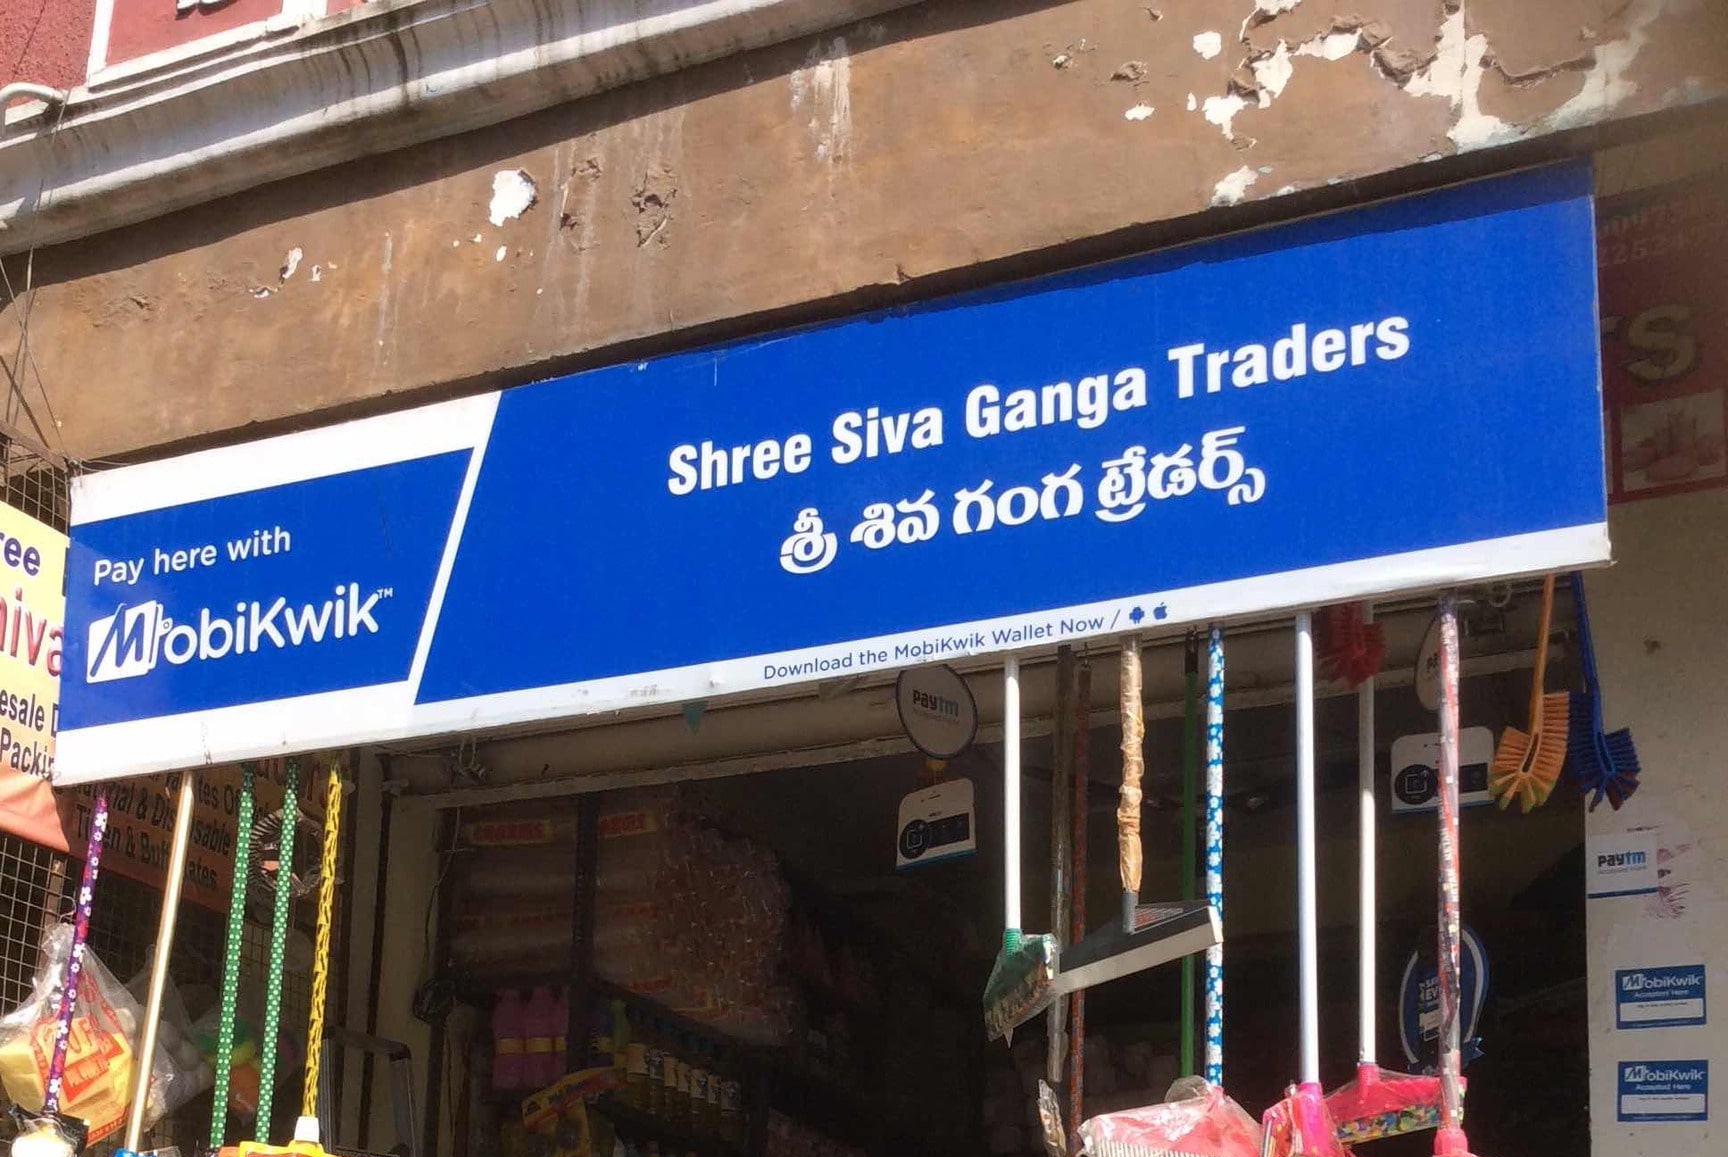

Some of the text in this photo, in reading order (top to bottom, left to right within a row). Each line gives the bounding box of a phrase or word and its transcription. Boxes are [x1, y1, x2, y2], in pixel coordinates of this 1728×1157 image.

[668, 316, 1411, 495] Shree Siva Ganga Traders
[779, 507, 838, 575] శ్రీ
[850, 488, 940, 550] శివ
[952, 463, 1084, 536] గంగ
[94, 526, 292, 586] Pay here with
[87, 581, 380, 684] MobiKwik
[763, 653, 853, 681] Download
[858, 648, 888, 666] the
[894, 632, 986, 661] MobiKwik
[992, 623, 1054, 646] Wallet
[1060, 616, 1105, 635] Now
[1622, 973, 1701, 991] MobiKwik
[1624, 1065, 1704, 1083] MobiKwik
